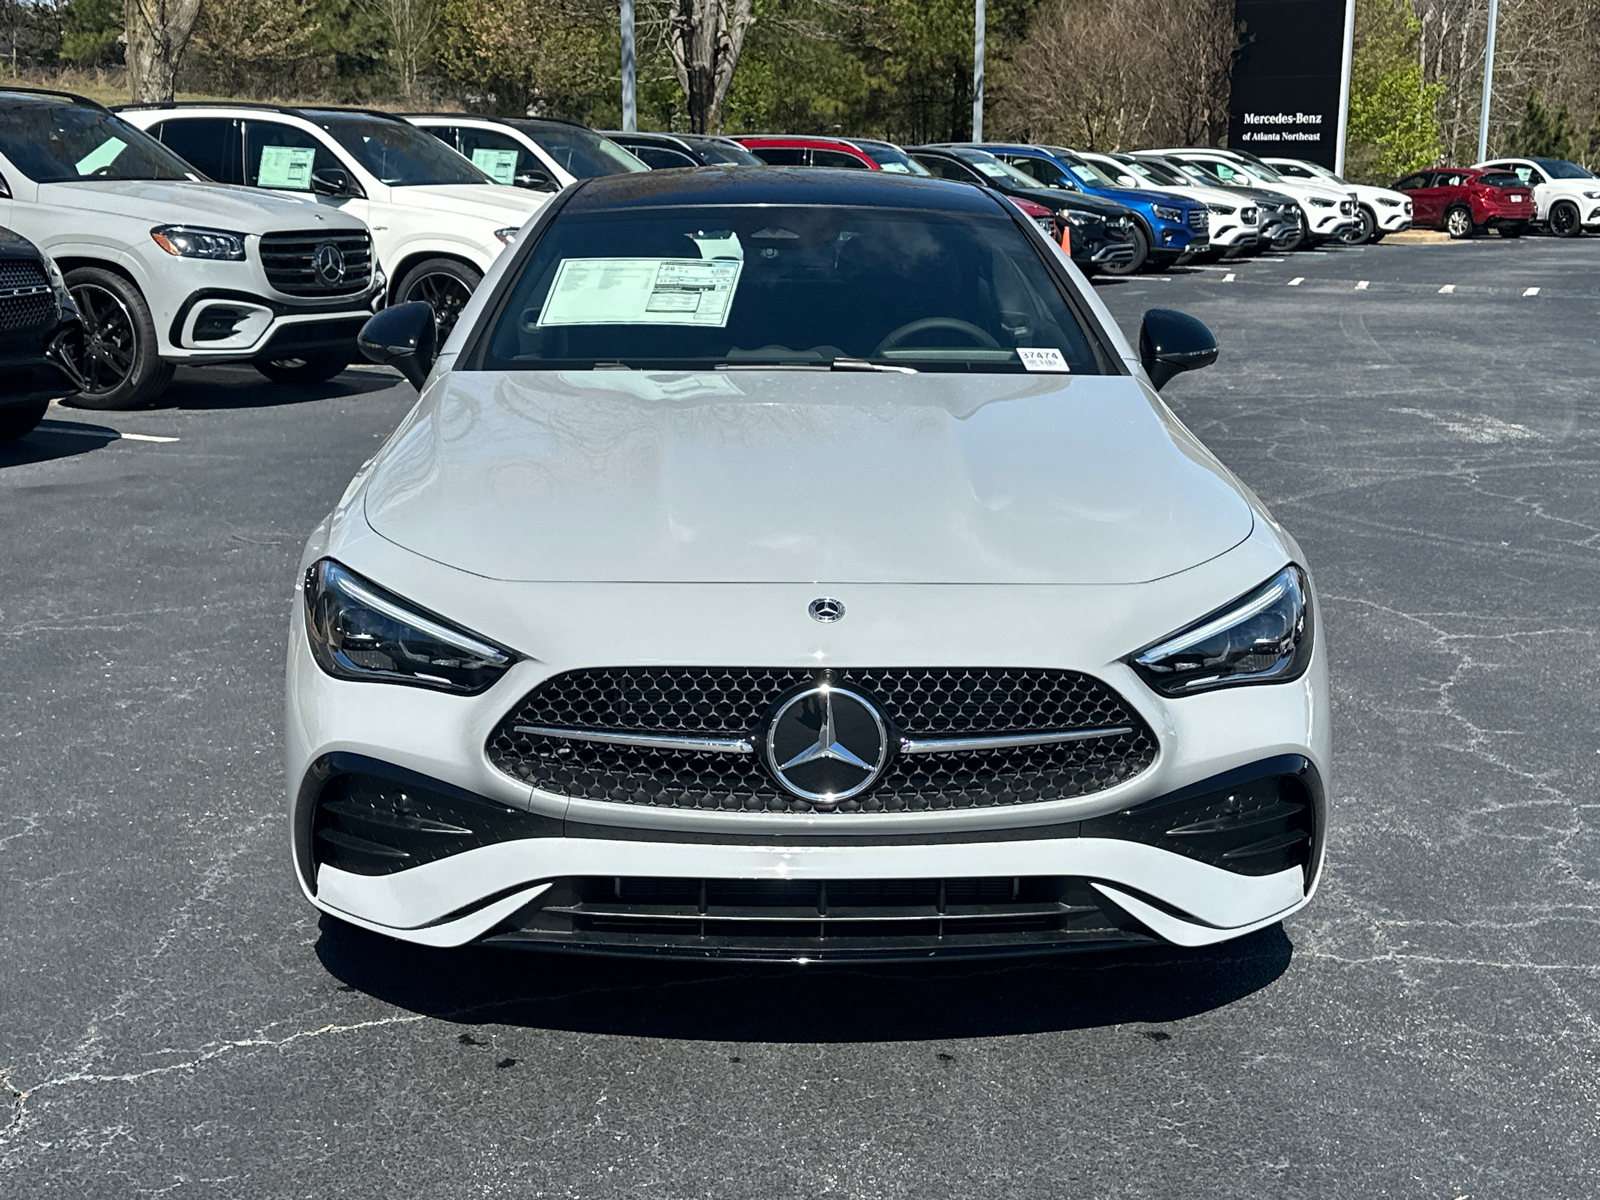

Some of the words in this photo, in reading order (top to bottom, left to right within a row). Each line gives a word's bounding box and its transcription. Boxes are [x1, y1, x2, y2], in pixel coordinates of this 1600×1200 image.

[1243, 112, 1322, 124] Mercedes-Benz
[1242, 132, 1251, 141] of
[1251, 132, 1280, 141] Atlanta
[1281, 132, 1321, 141] Northeast
